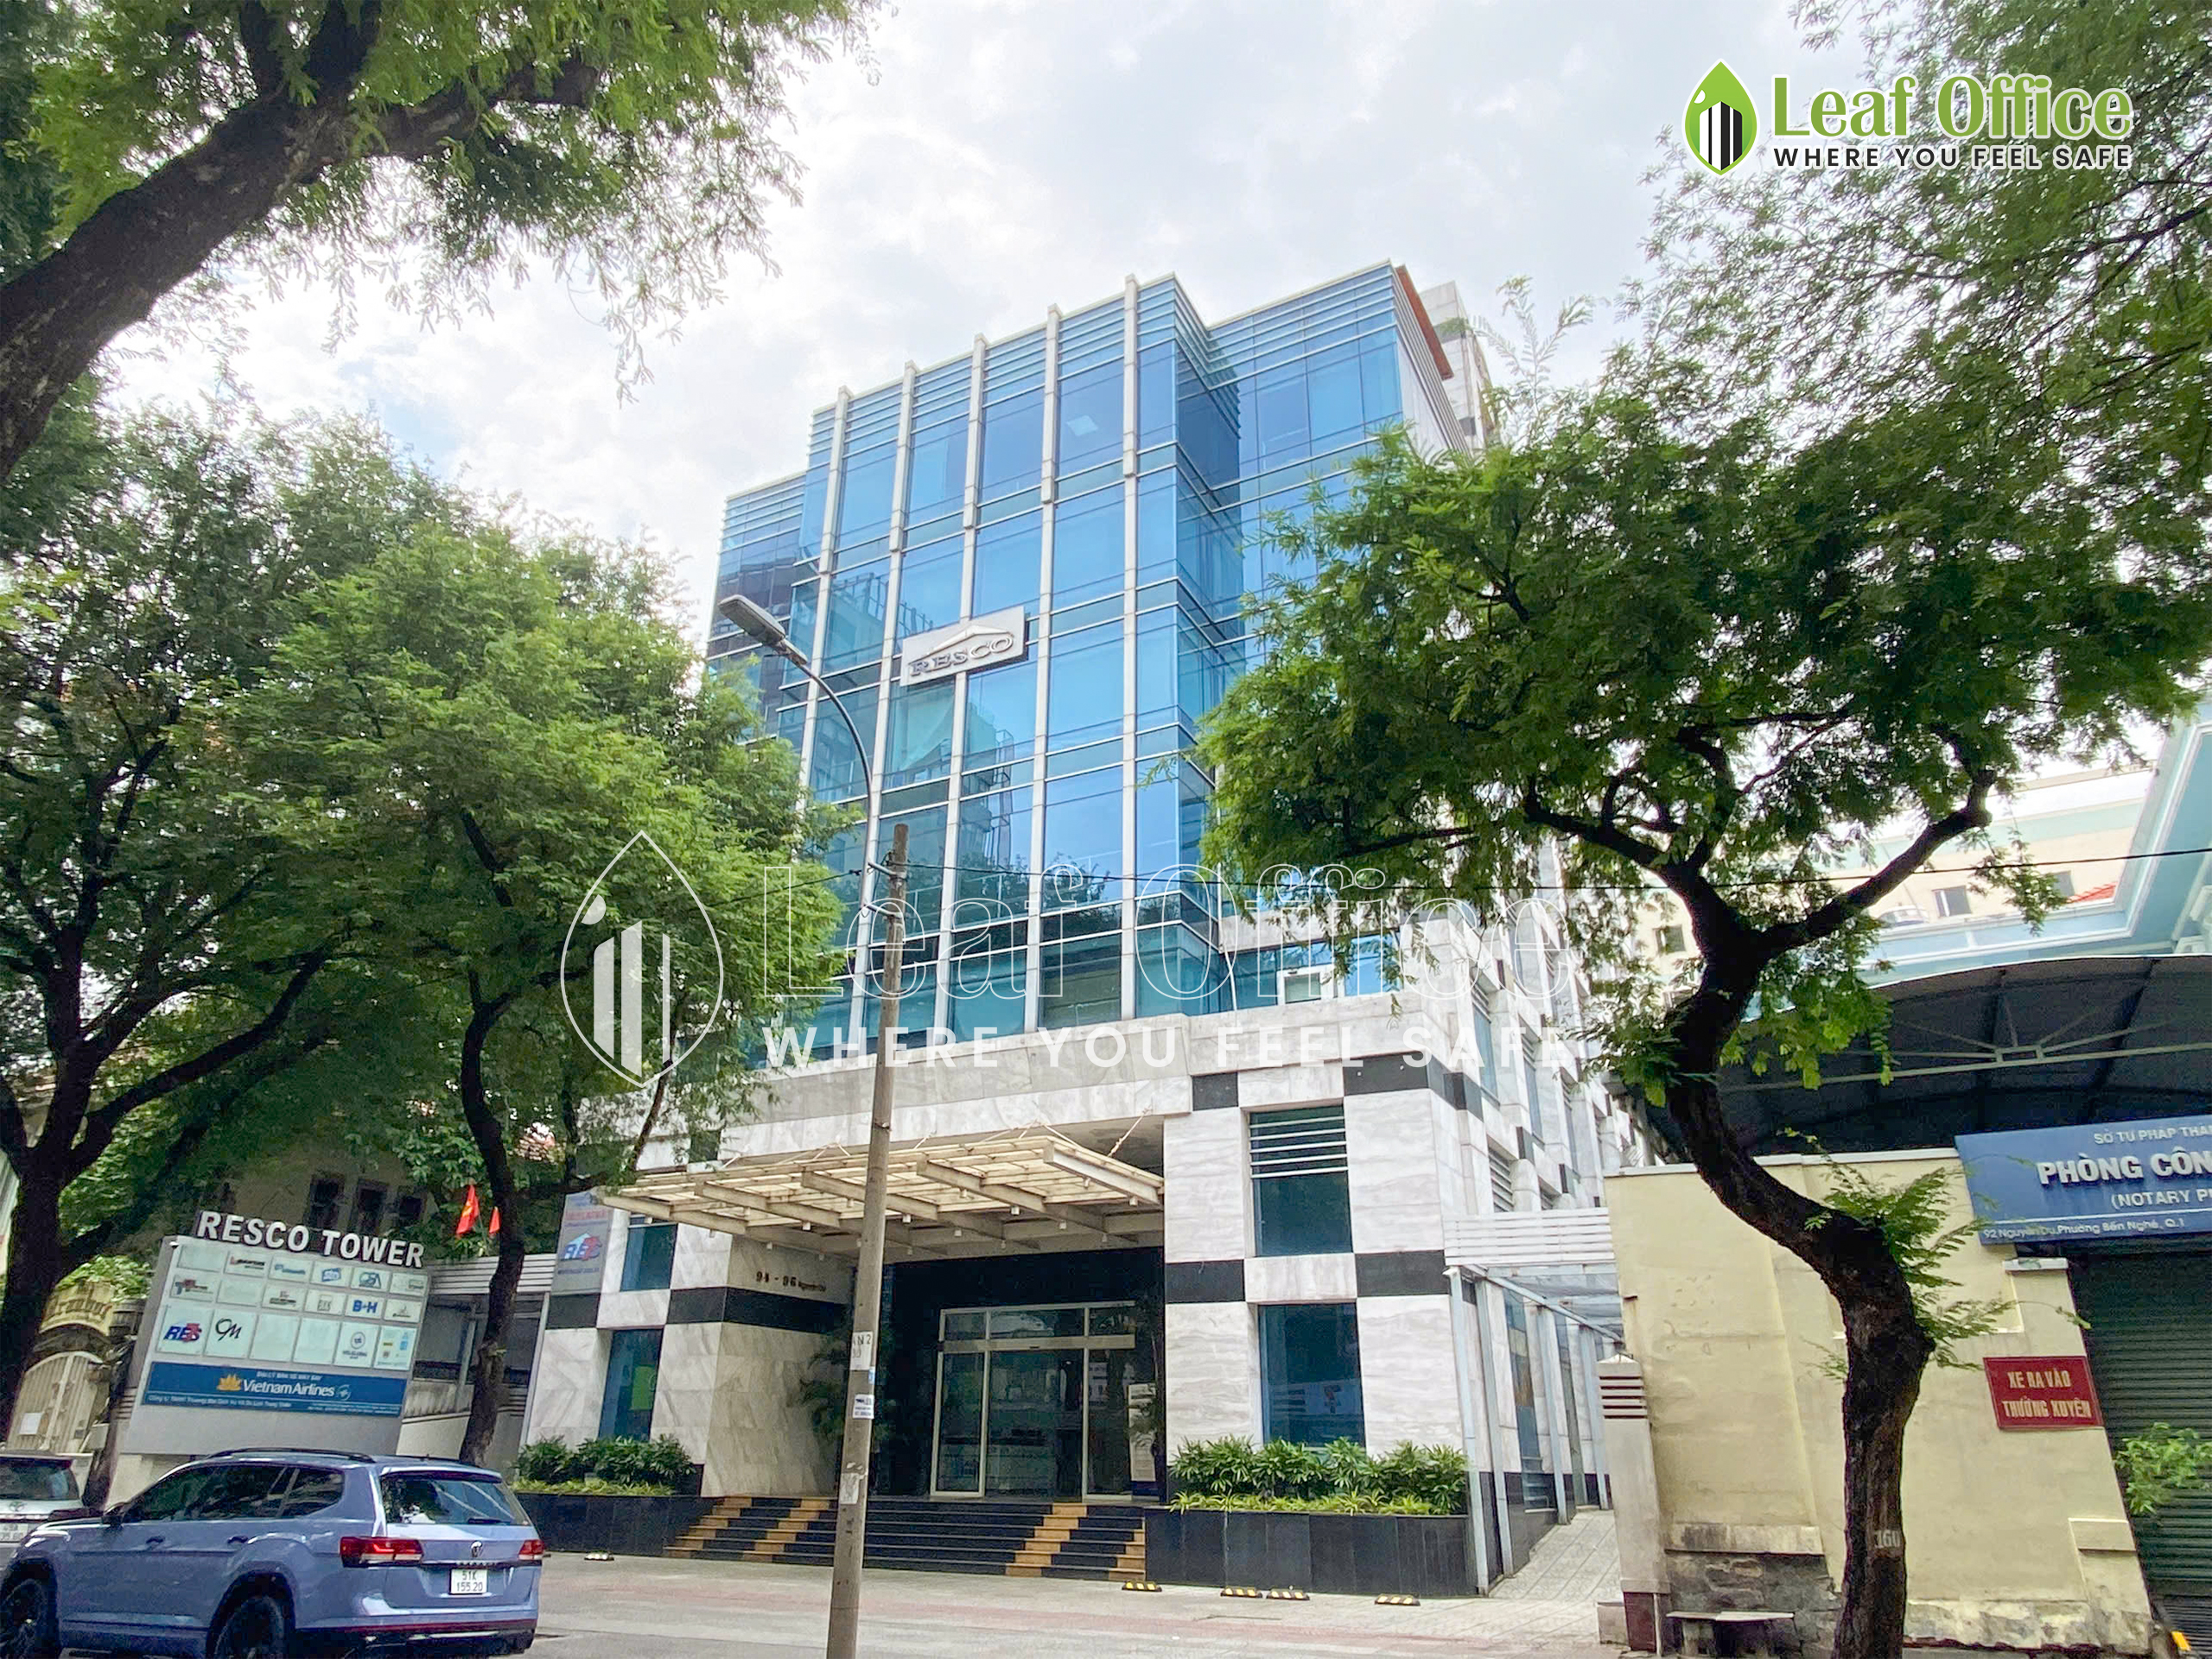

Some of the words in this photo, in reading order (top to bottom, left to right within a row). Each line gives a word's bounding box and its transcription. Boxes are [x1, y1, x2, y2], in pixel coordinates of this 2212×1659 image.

[910, 635, 1014, 677] RESCO
[2037, 1152, 2145, 1185] PHÒNG
[2111, 1190, 2190, 1210] (NOTARY
[197, 1211, 310, 1252] RESCO
[321, 1229, 425, 1268] TOWER
[1983, 1229, 1999, 1239] 92
[243, 1378, 294, 1394] Vietnam
[292, 1382, 335, 1397] Airlines
[2007, 1371, 2025, 1389] XE
[2026, 1371, 2045, 1389] RA
